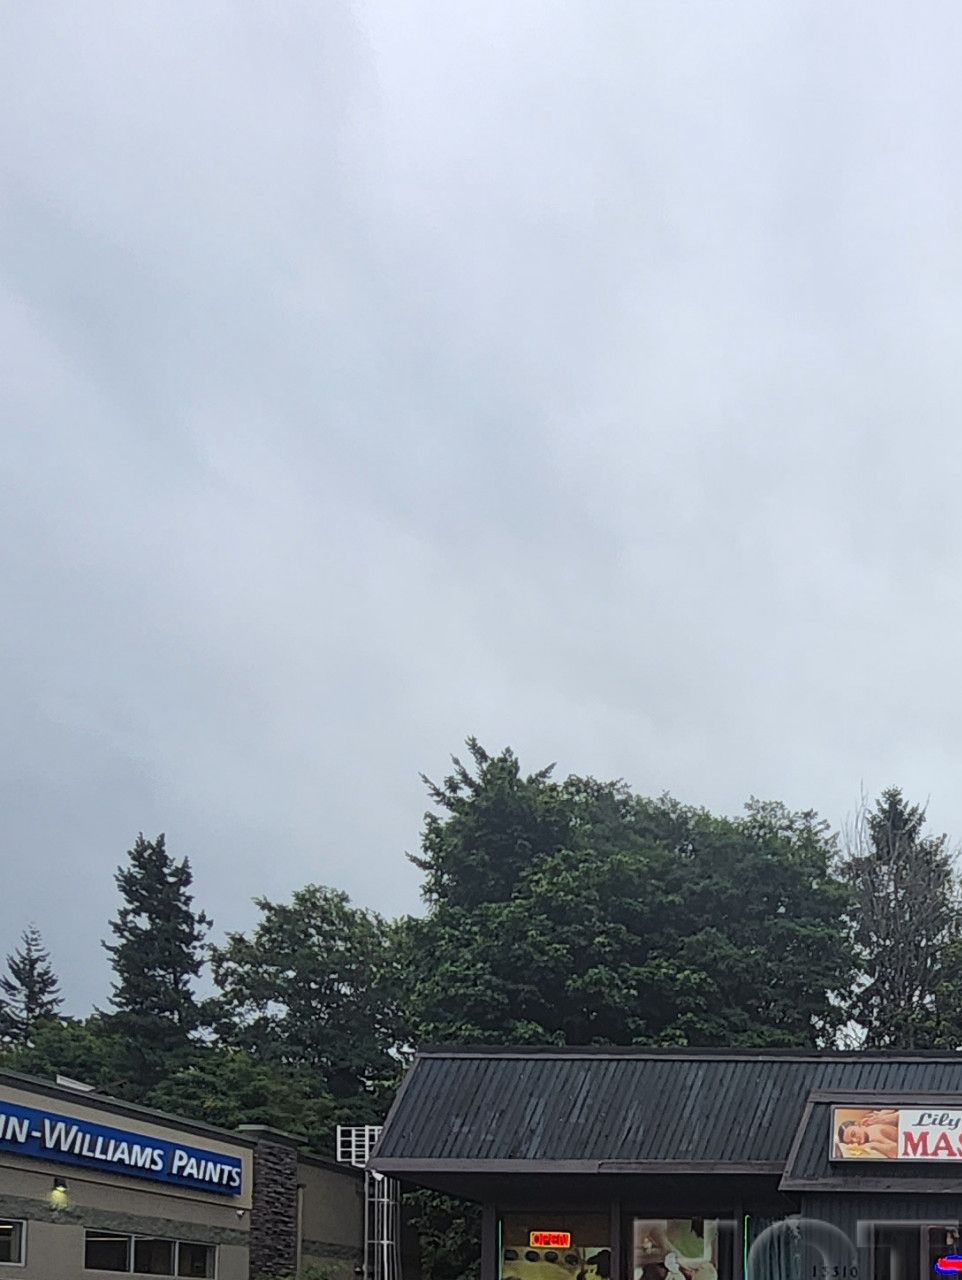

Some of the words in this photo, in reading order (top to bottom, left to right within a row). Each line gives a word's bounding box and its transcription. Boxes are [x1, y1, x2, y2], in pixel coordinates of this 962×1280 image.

[912, 1112, 961, 1130] Lily
[172, 1149, 241, 1187] PAINTS
[532, 1232, 569, 1247] OPEN
